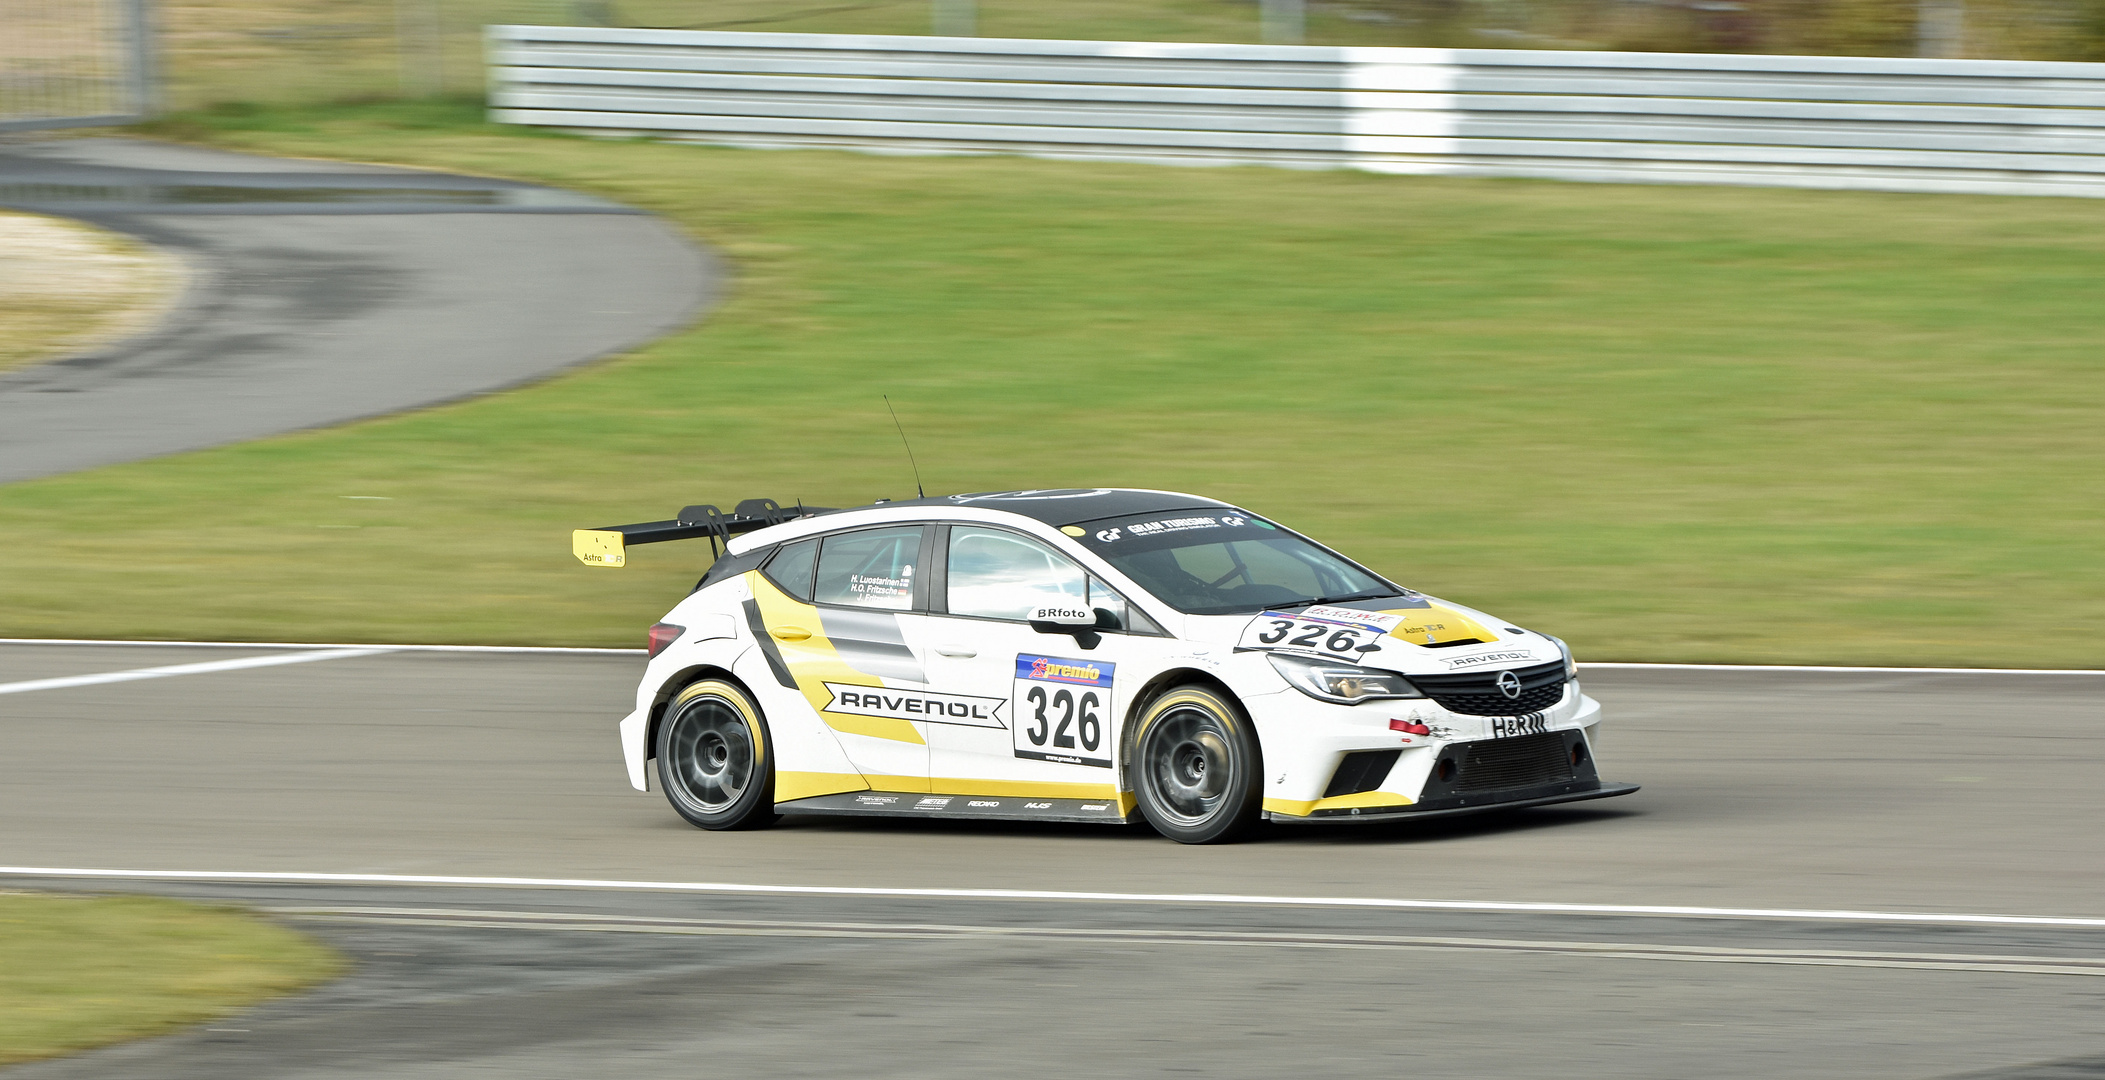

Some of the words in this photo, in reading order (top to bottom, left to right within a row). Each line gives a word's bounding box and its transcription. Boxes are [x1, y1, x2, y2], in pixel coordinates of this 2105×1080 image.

[1127, 521, 1165, 533] GRAN
[1161, 517, 1216, 528] TURISMO
[850, 574, 858, 583] H.
[859, 575, 900, 587] Luostarinen
[850, 583, 865, 592] H.O.
[866, 585, 898, 595] Fritzsche
[1038, 608, 1086, 618] BRfoto
[1259, 620, 1360, 651] 326
[1453, 652, 1529, 665] RAVENOL
[1044, 663, 1100, 680] premio
[841, 691, 988, 719] RAVENOL
[1027, 685, 1100, 752] 326
